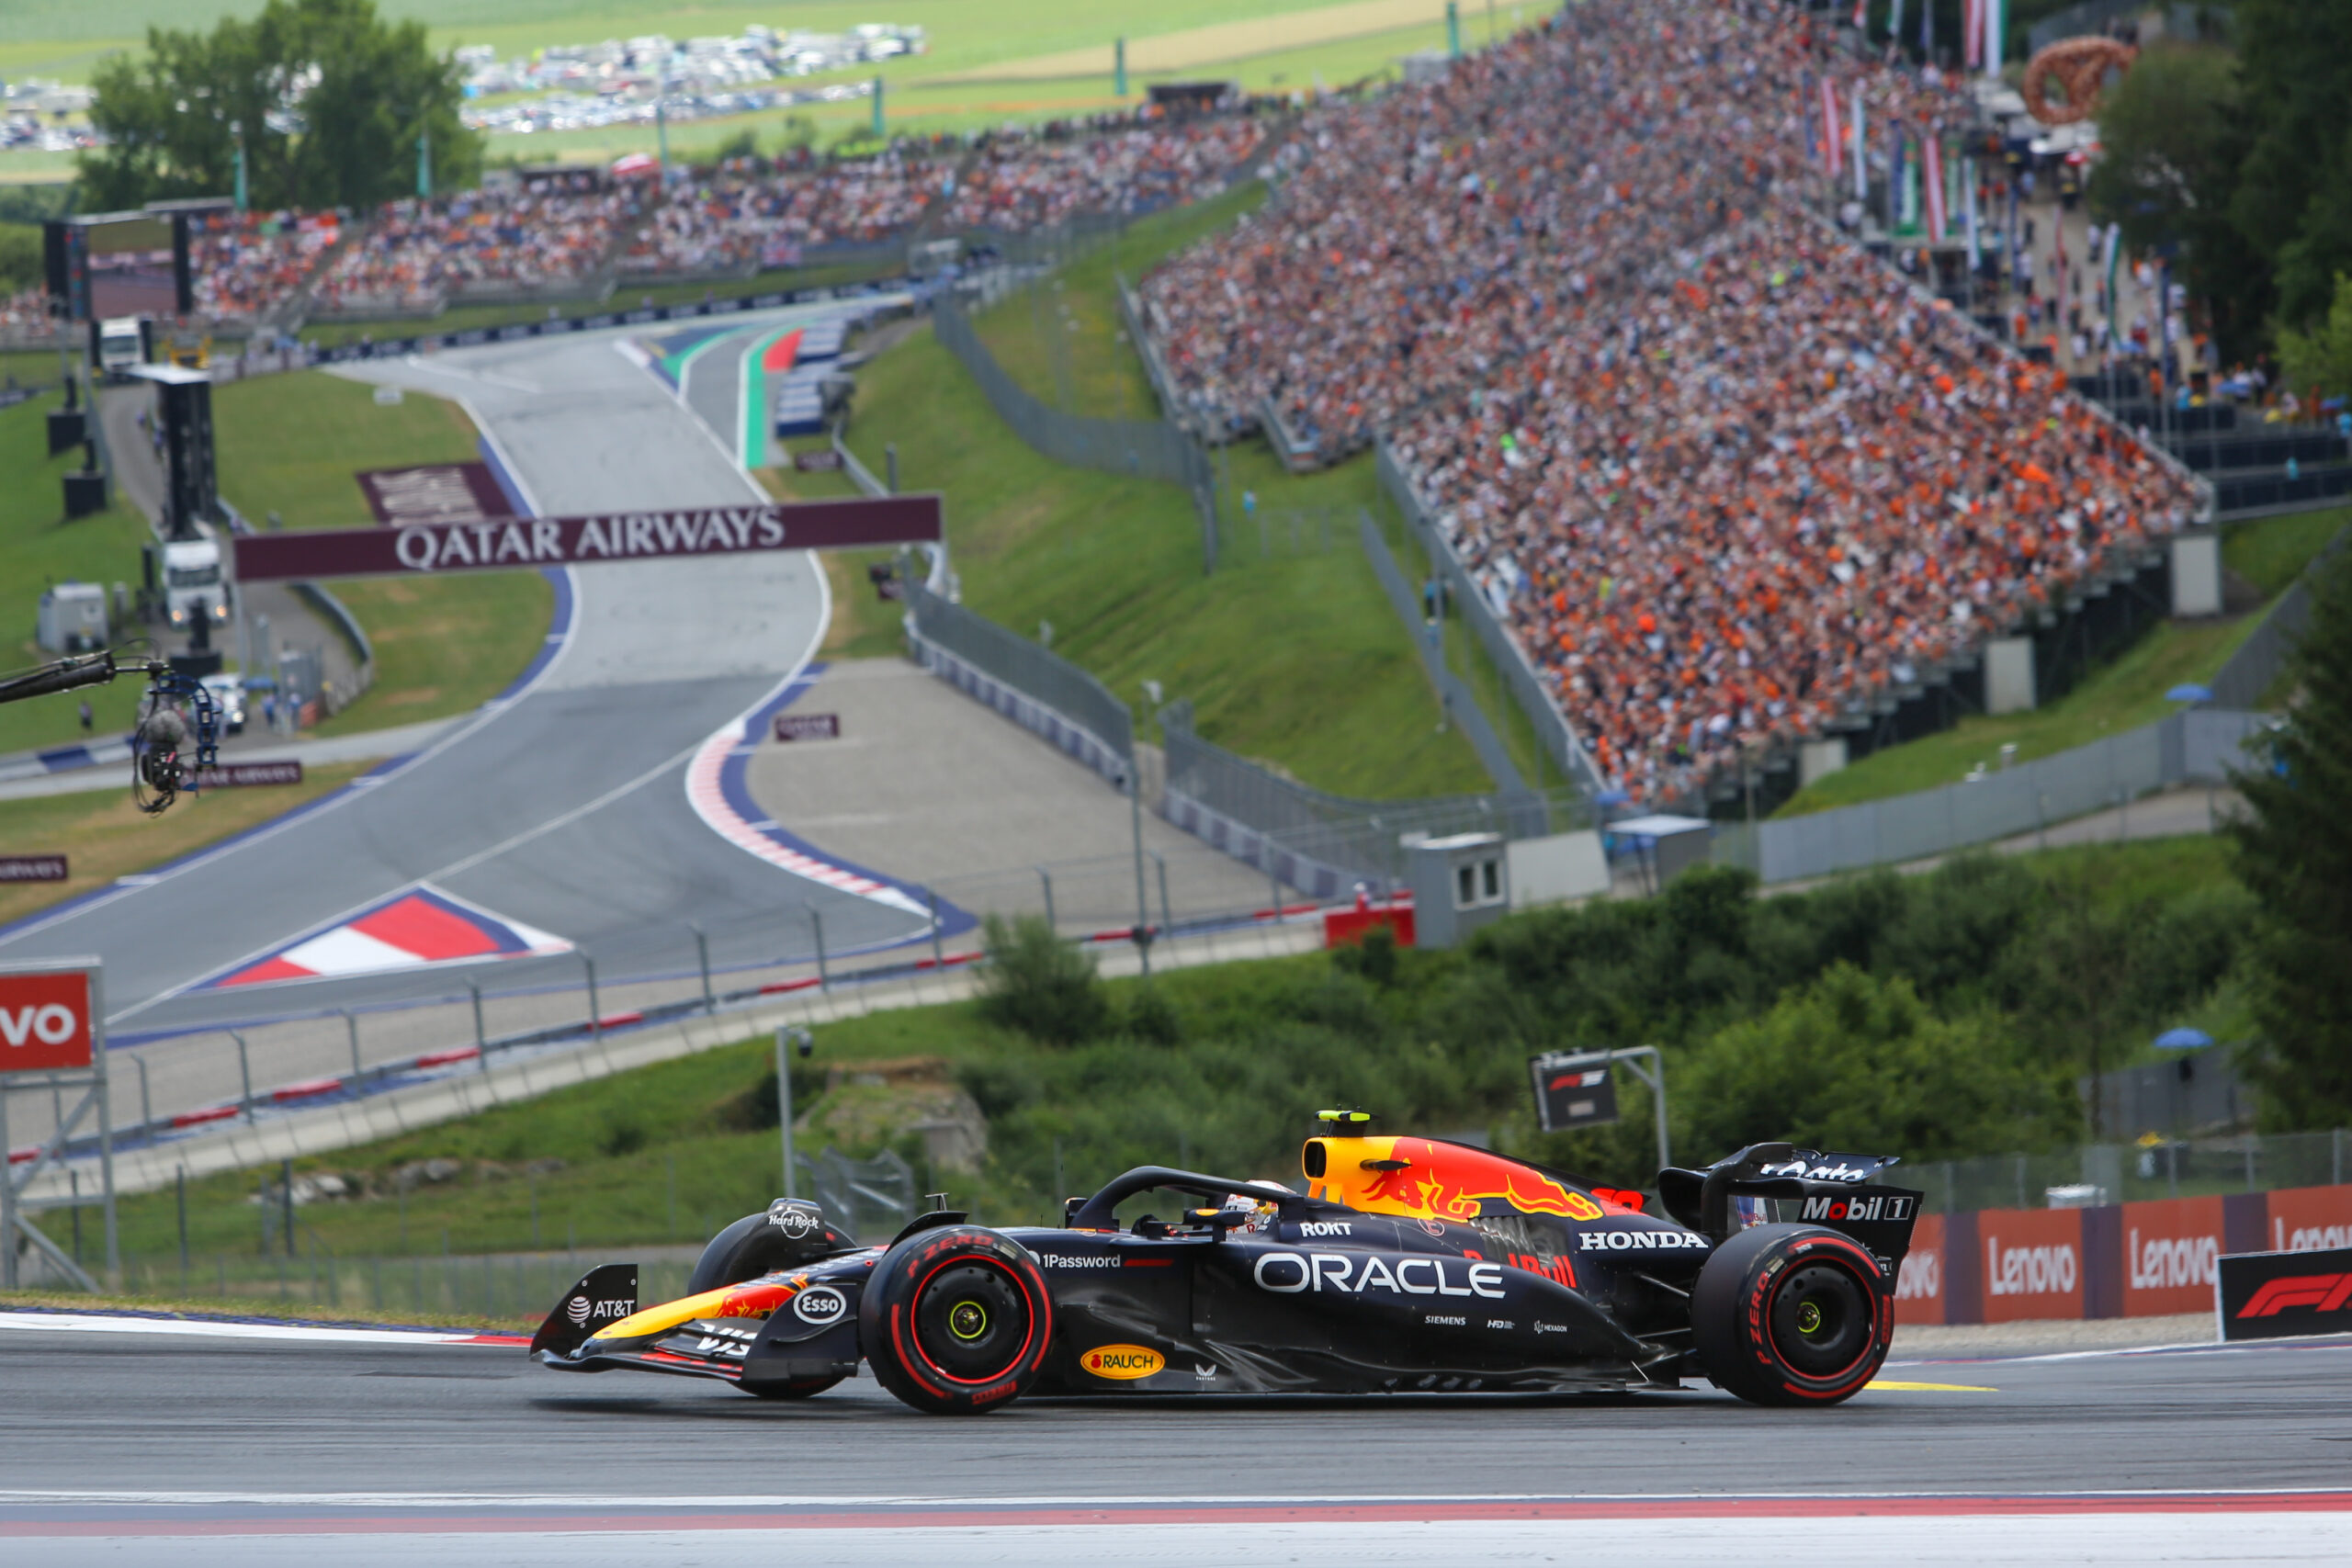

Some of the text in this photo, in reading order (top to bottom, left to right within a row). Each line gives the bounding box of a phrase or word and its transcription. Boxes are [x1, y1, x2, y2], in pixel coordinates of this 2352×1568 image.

[395, 508, 785, 570] QATAR AIRWAYS
[1803, 1197, 1905, 1221] Mobil 1
[769, 1214, 819, 1229] Hard Rock
[1299, 1222, 1352, 1237] ROKT
[922, 1235, 995, 1261] ZERO
[1578, 1231, 1709, 1250] HONDA
[1043, 1254, 1121, 1269] 1Password
[1988, 1236, 2076, 1295] Lenovo
[2130, 1227, 2218, 1289] Lenovo
[1253, 1253, 1506, 1299] ORACLE
[594, 1300, 635, 1317] AT&T
[802, 1295, 839, 1313] Esso
[1749, 1271, 1770, 1345] ZERO
[1425, 1315, 1466, 1325] SIEMENS
[1544, 1325, 1567, 1333] HEXAGON
[1103, 1355, 1153, 1369] RAUCH
